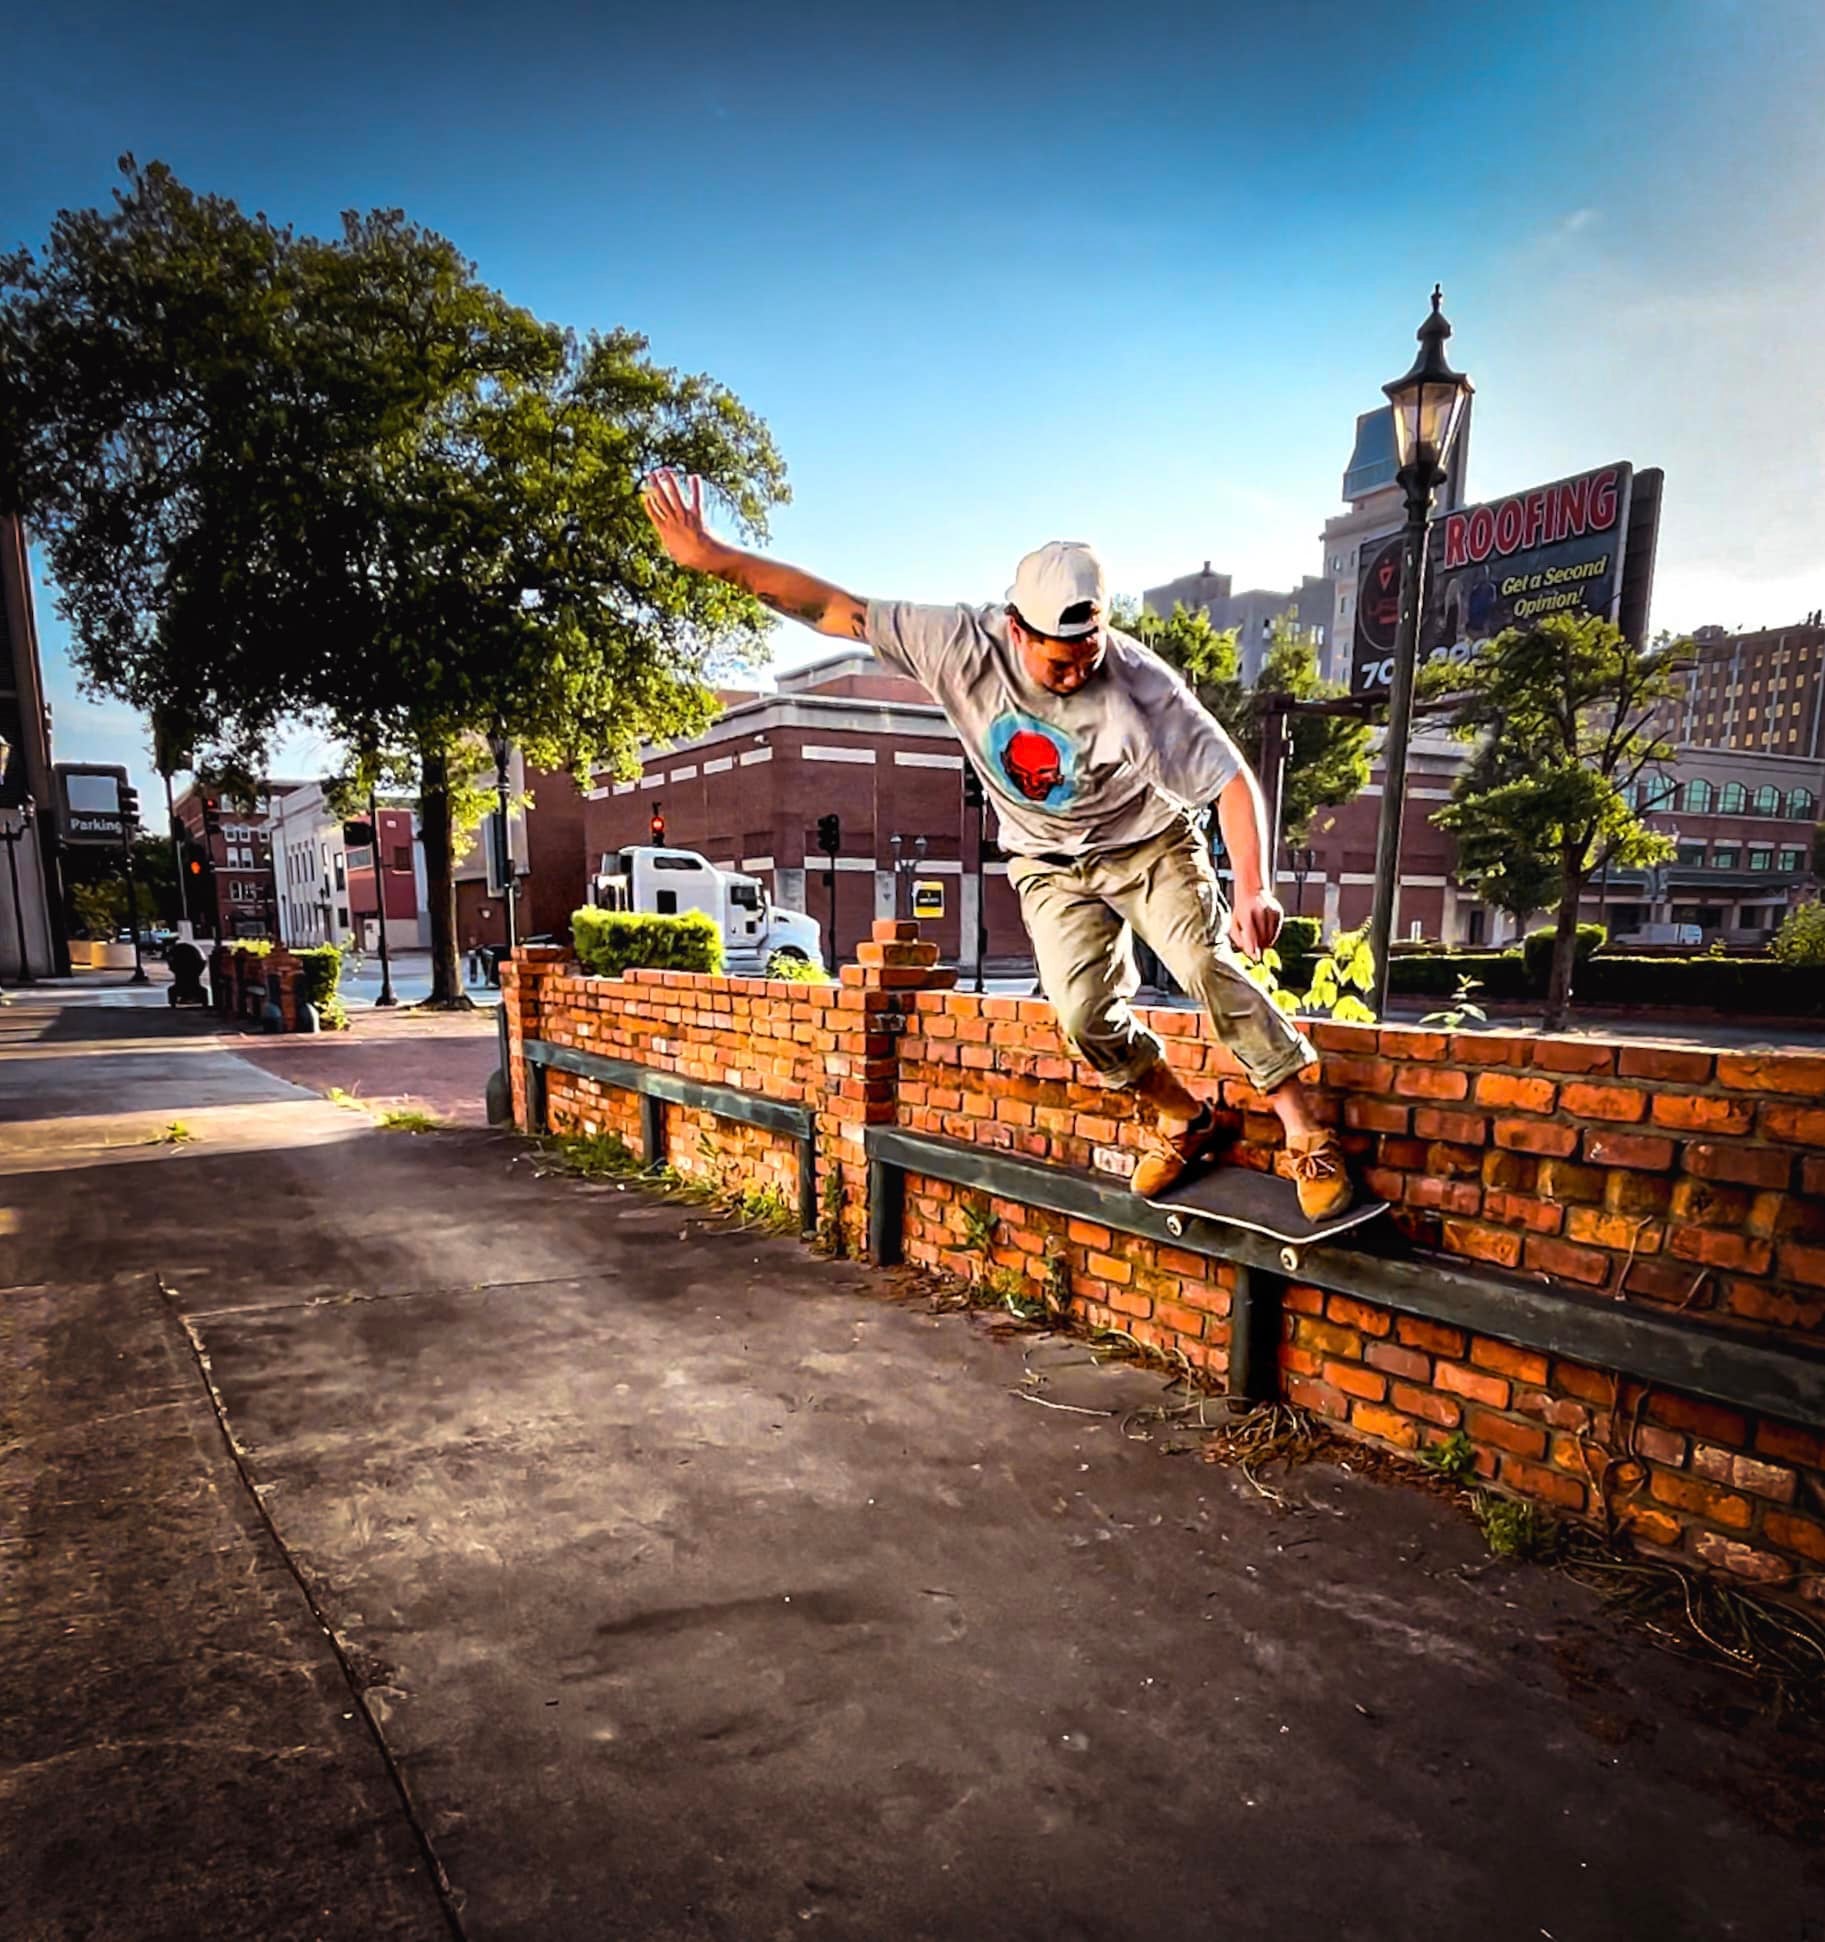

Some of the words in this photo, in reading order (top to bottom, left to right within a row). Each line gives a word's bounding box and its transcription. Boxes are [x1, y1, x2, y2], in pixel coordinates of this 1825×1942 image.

[1444, 469, 1617, 570] ROOFING
[1501, 576, 1529, 596] Get
[1529, 575, 1542, 590] a
[1543, 555, 1607, 586] Second
[1513, 585, 1585, 619] Opinion!
[70, 818, 123, 834] Parking
